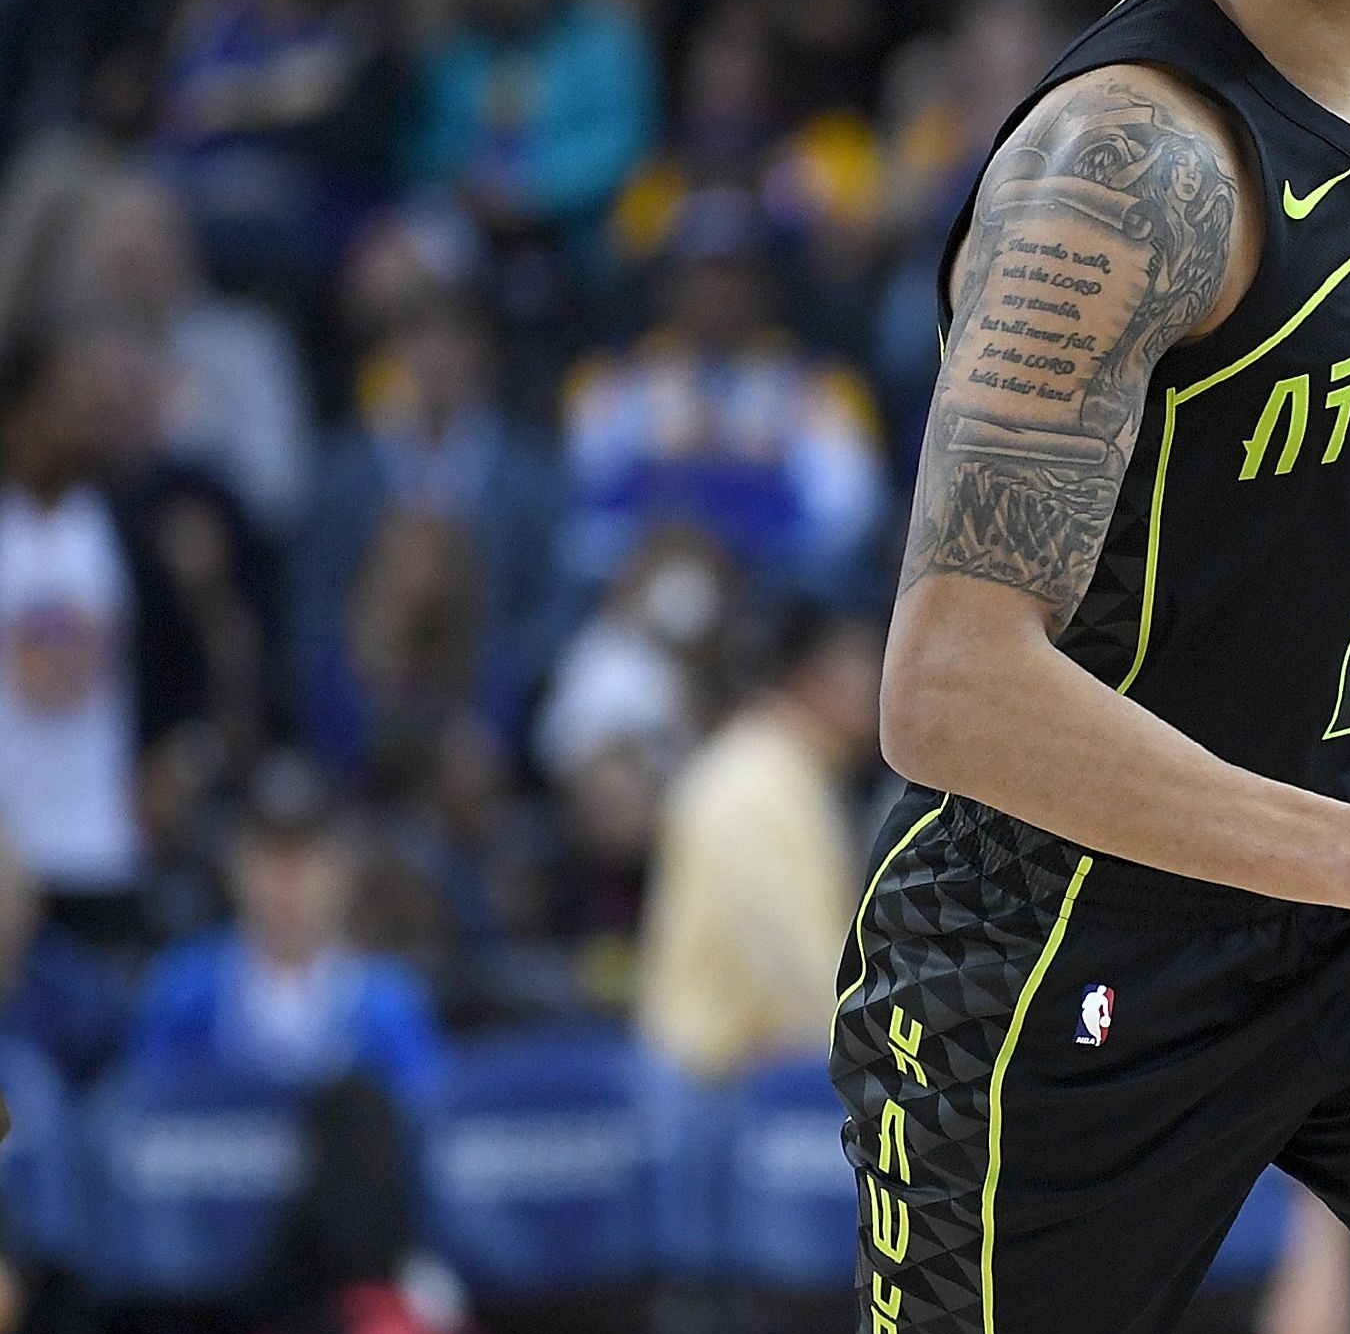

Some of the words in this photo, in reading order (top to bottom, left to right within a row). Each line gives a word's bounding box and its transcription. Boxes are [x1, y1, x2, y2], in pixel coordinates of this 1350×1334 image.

[1028, 267, 1050, 283] the
[1050, 273, 1102, 296] LORD
[1026, 328, 1065, 343] never
[978, 342, 1001, 359] for
[1001, 347, 1023, 363] the
[1023, 354, 1076, 375] LORD
[1036, 382, 1075, 402] hand
[1075, 1036, 1096, 1045] NBA
